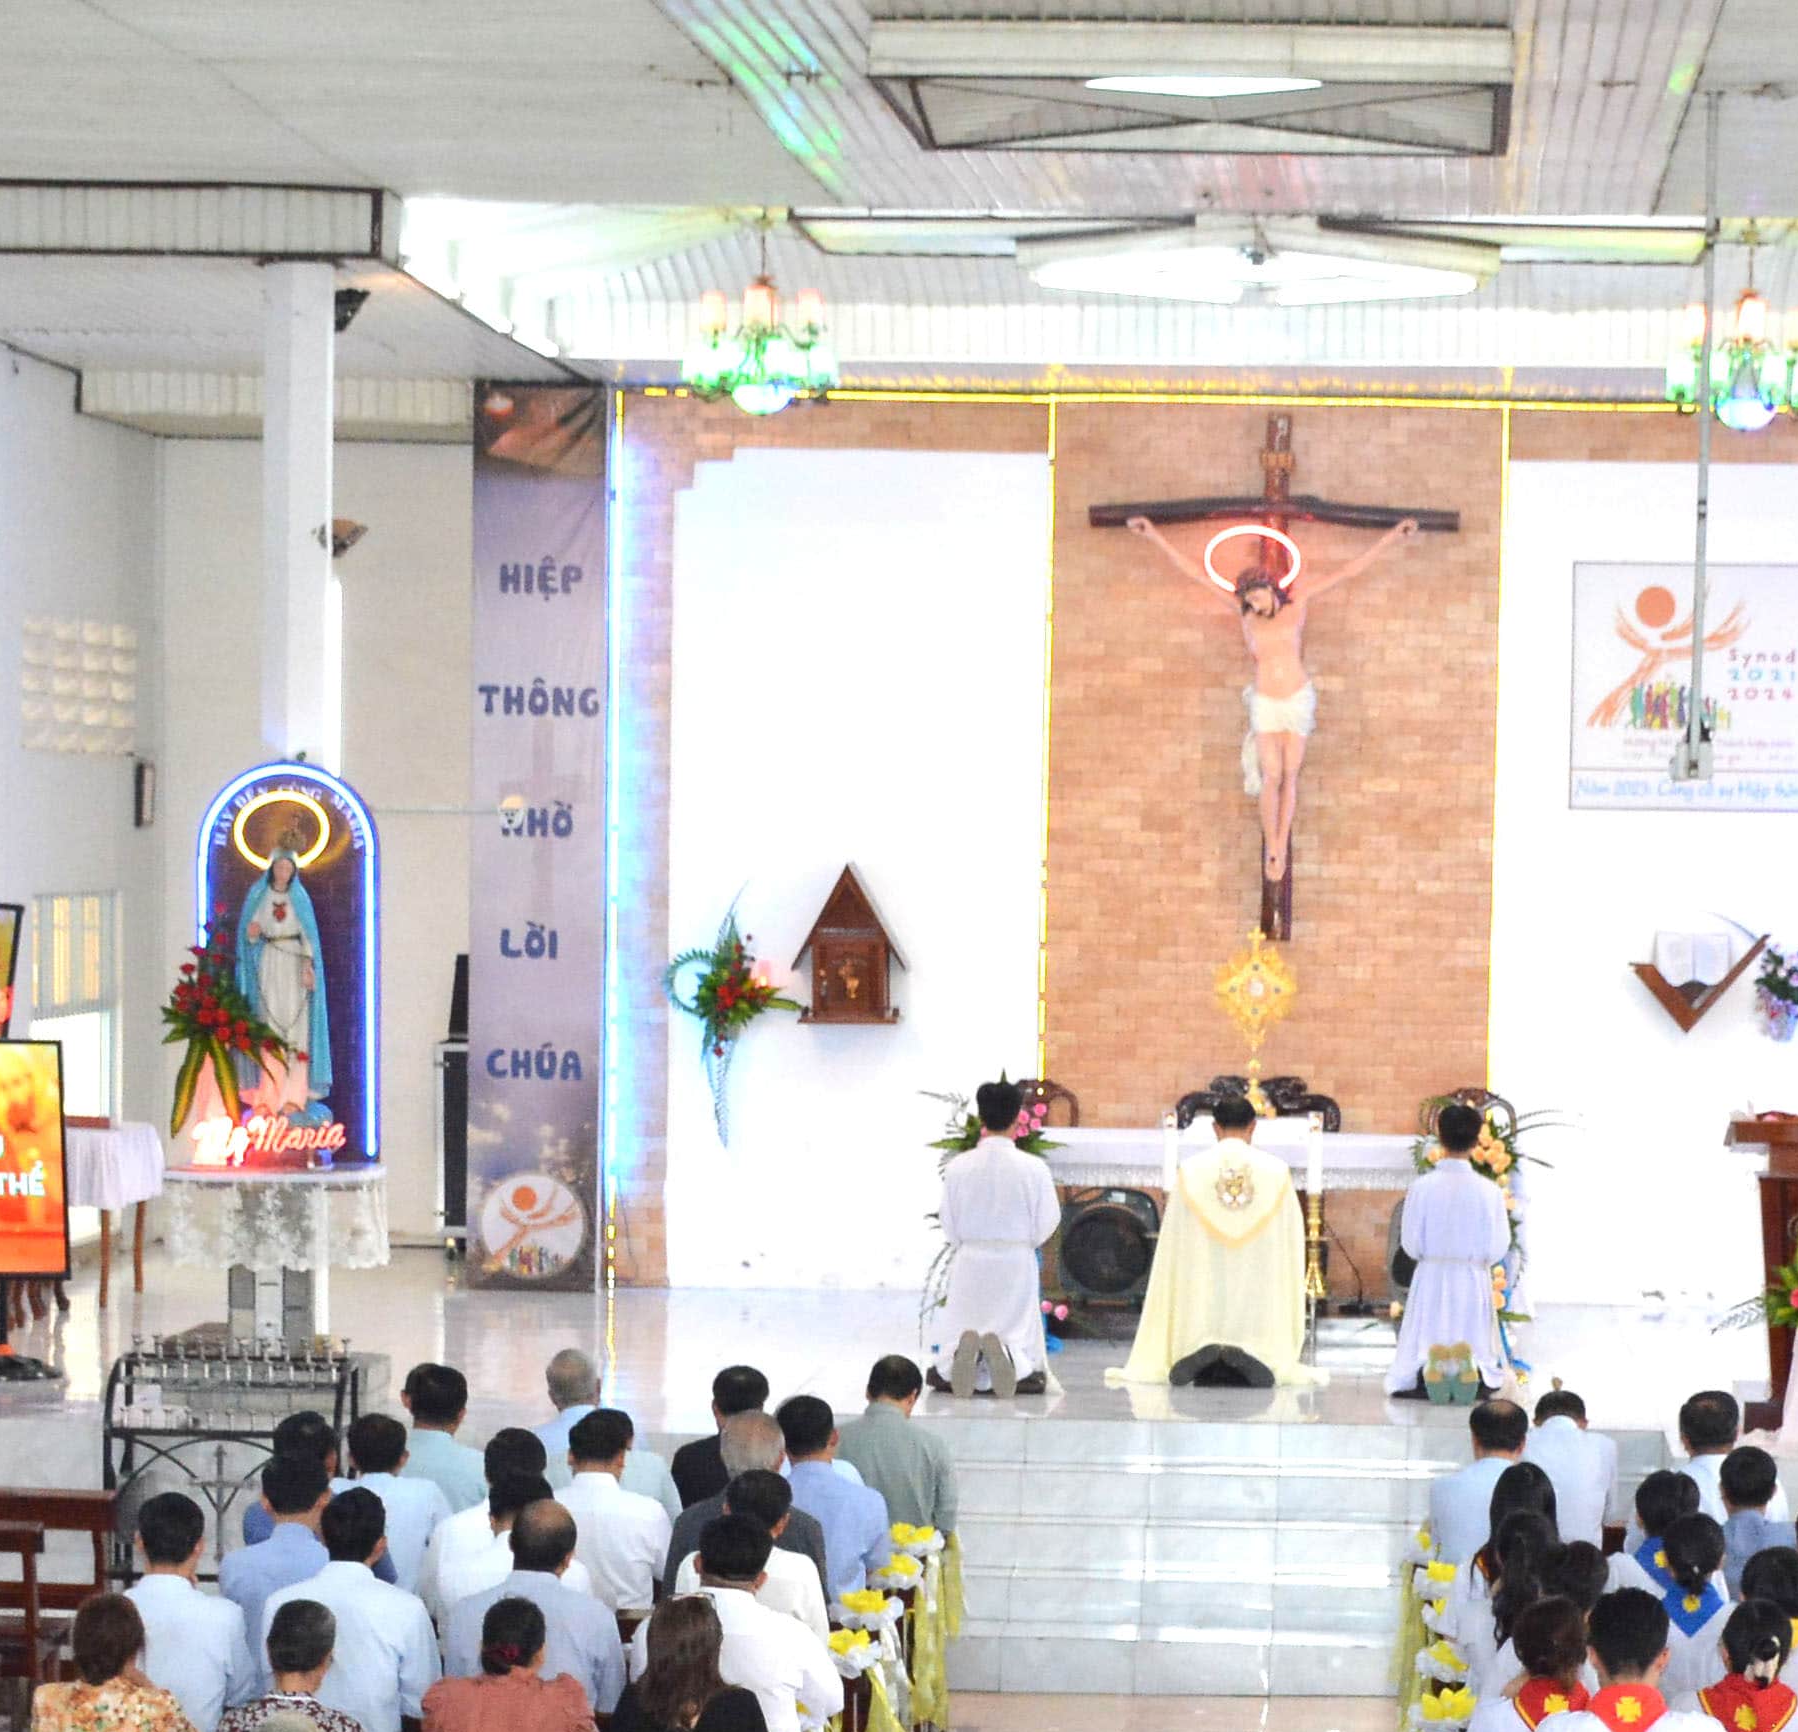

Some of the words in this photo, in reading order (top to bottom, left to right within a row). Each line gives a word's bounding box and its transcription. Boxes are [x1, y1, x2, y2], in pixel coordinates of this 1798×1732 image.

[499, 555, 583, 601] HIỆP
[1729, 648, 1795, 668] Synod
[478, 677, 600, 717] THÔNG
[500, 920, 558, 959] LỜI
[486, 1042, 582, 1080] CHÚA
[248, 1116, 346, 1153] Maria
